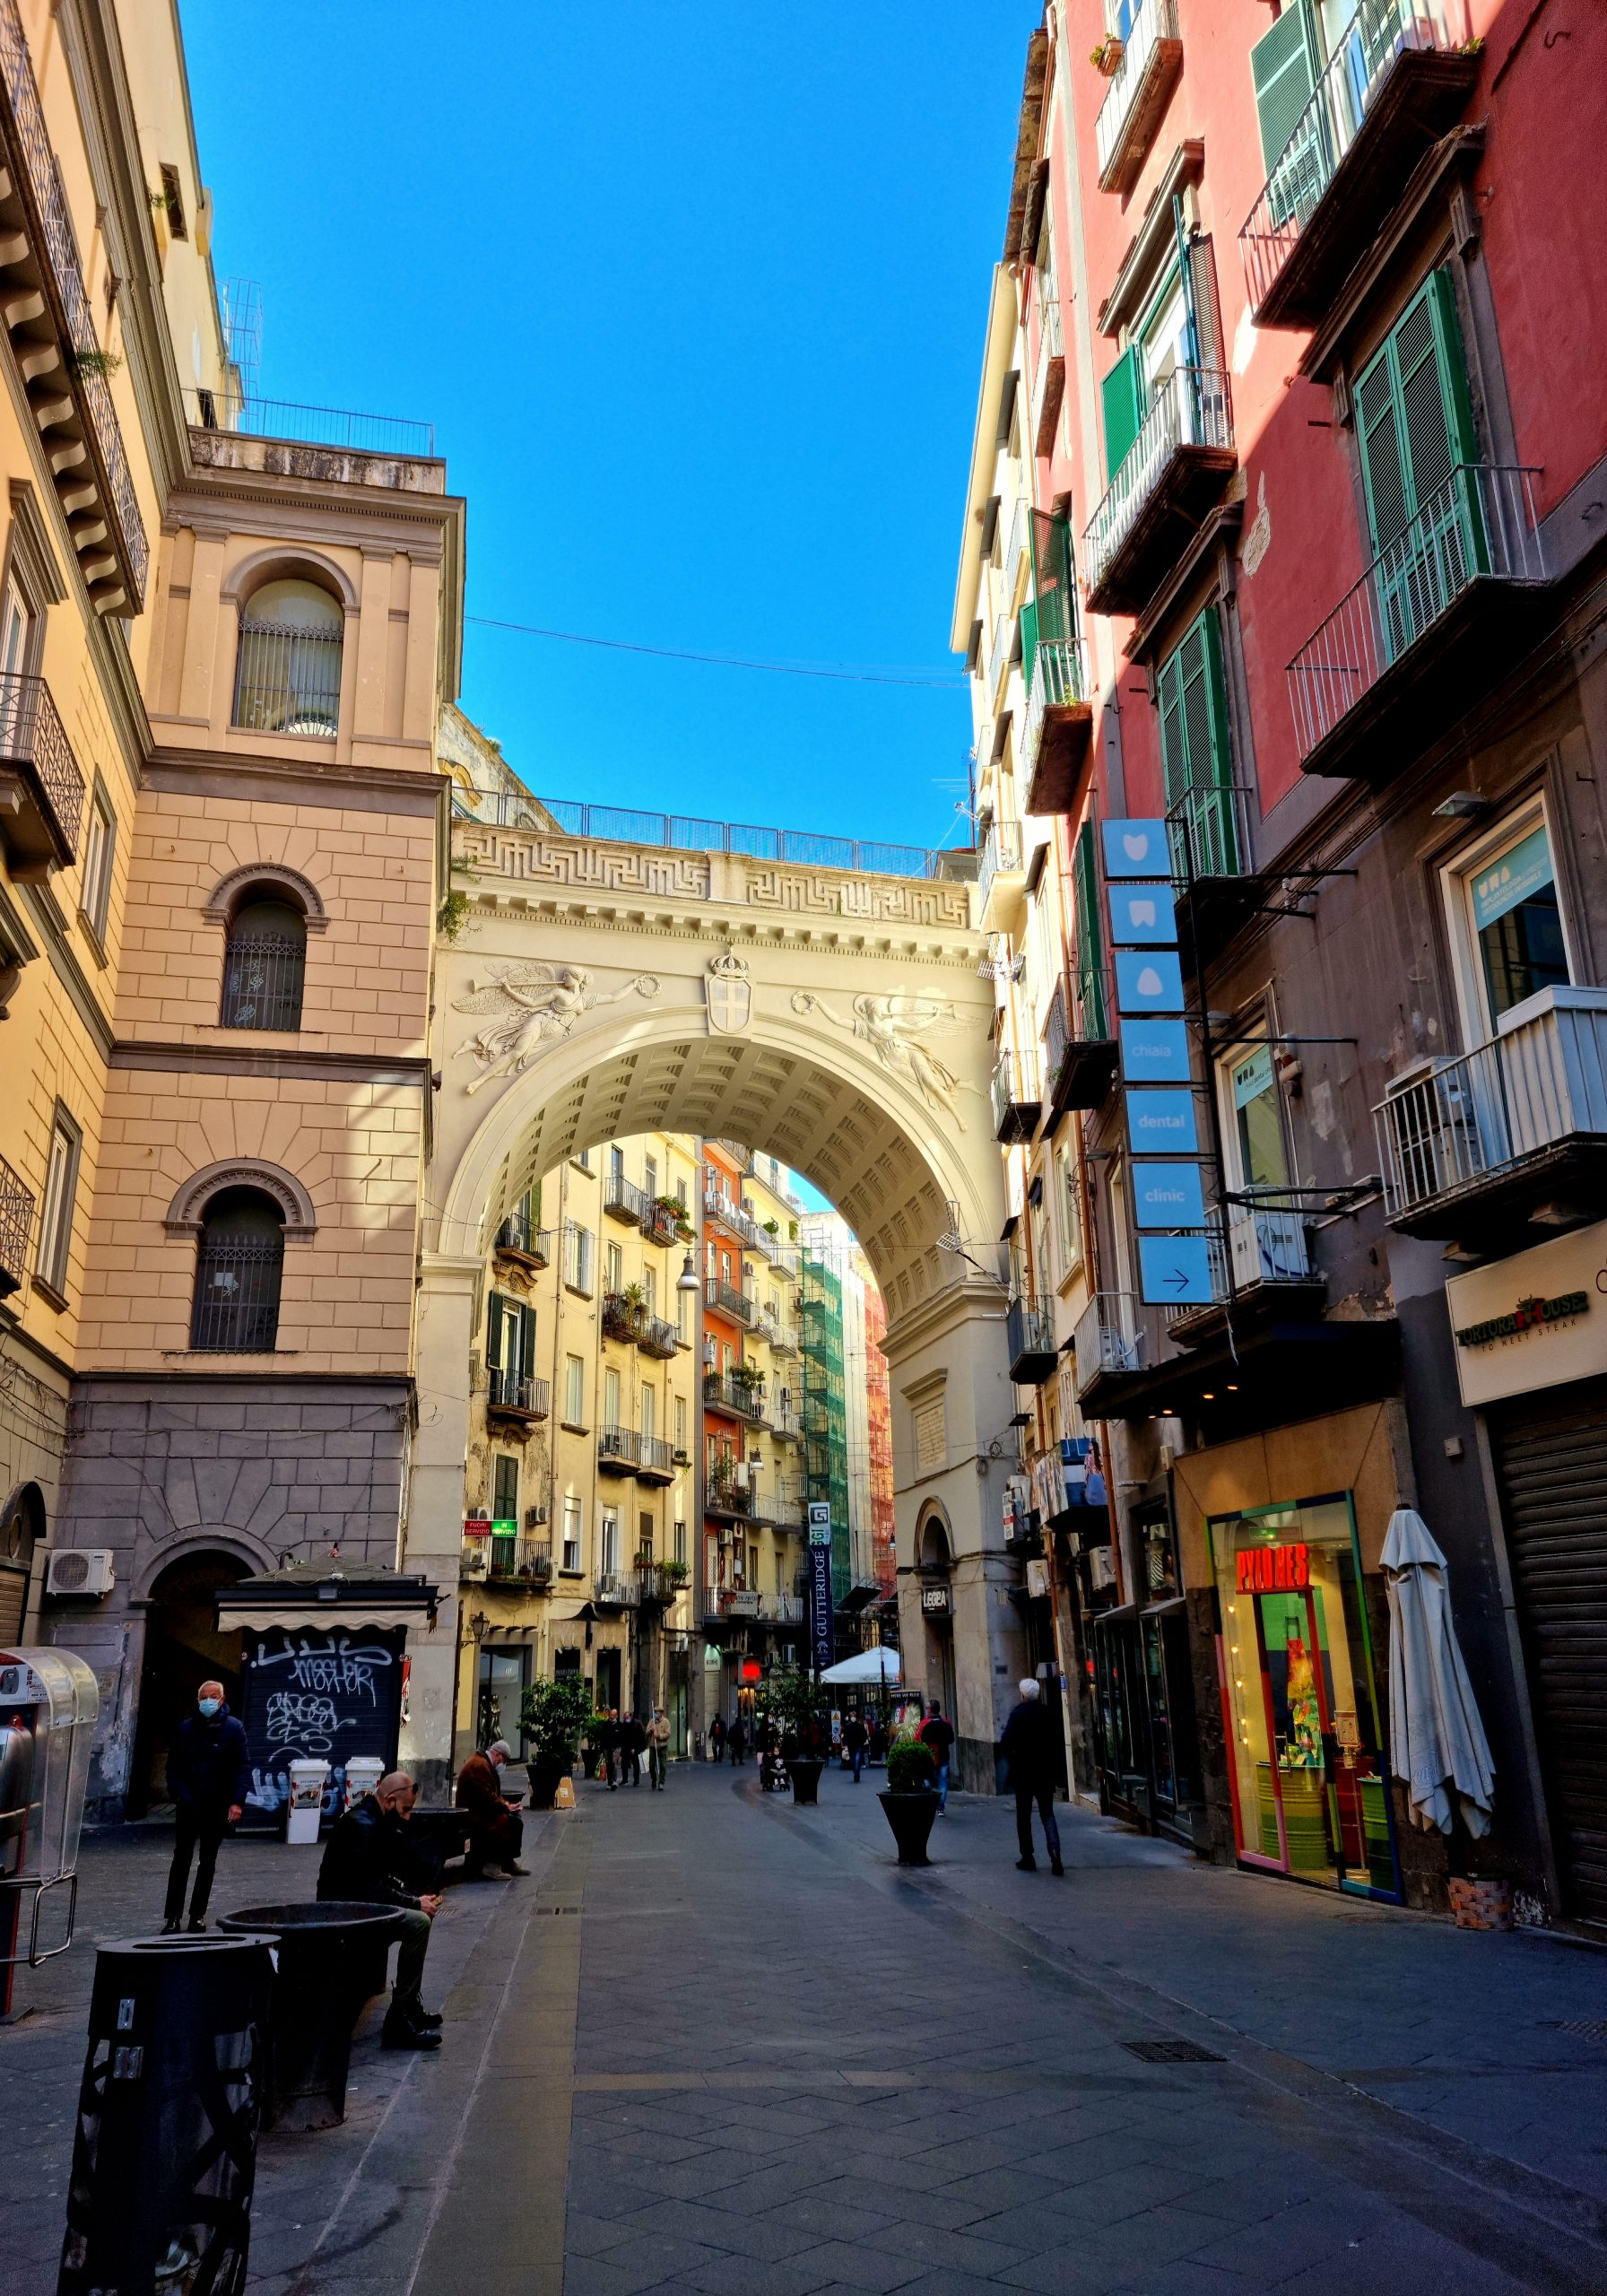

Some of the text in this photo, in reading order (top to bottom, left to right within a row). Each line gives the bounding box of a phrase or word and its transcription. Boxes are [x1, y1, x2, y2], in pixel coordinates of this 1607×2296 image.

[1133, 1044, 1172, 1057] chiaia
[1139, 1114, 1186, 1127] dental
[1145, 1188, 1186, 1203] clinic
[1455, 1312, 1517, 1346] TORTORA
[1481, 1318, 1577, 1353] TO MEET STEAK
[1236, 1543, 1308, 1591] PYLONES
[815, 1551, 828, 1637] GUTTERIDGE
